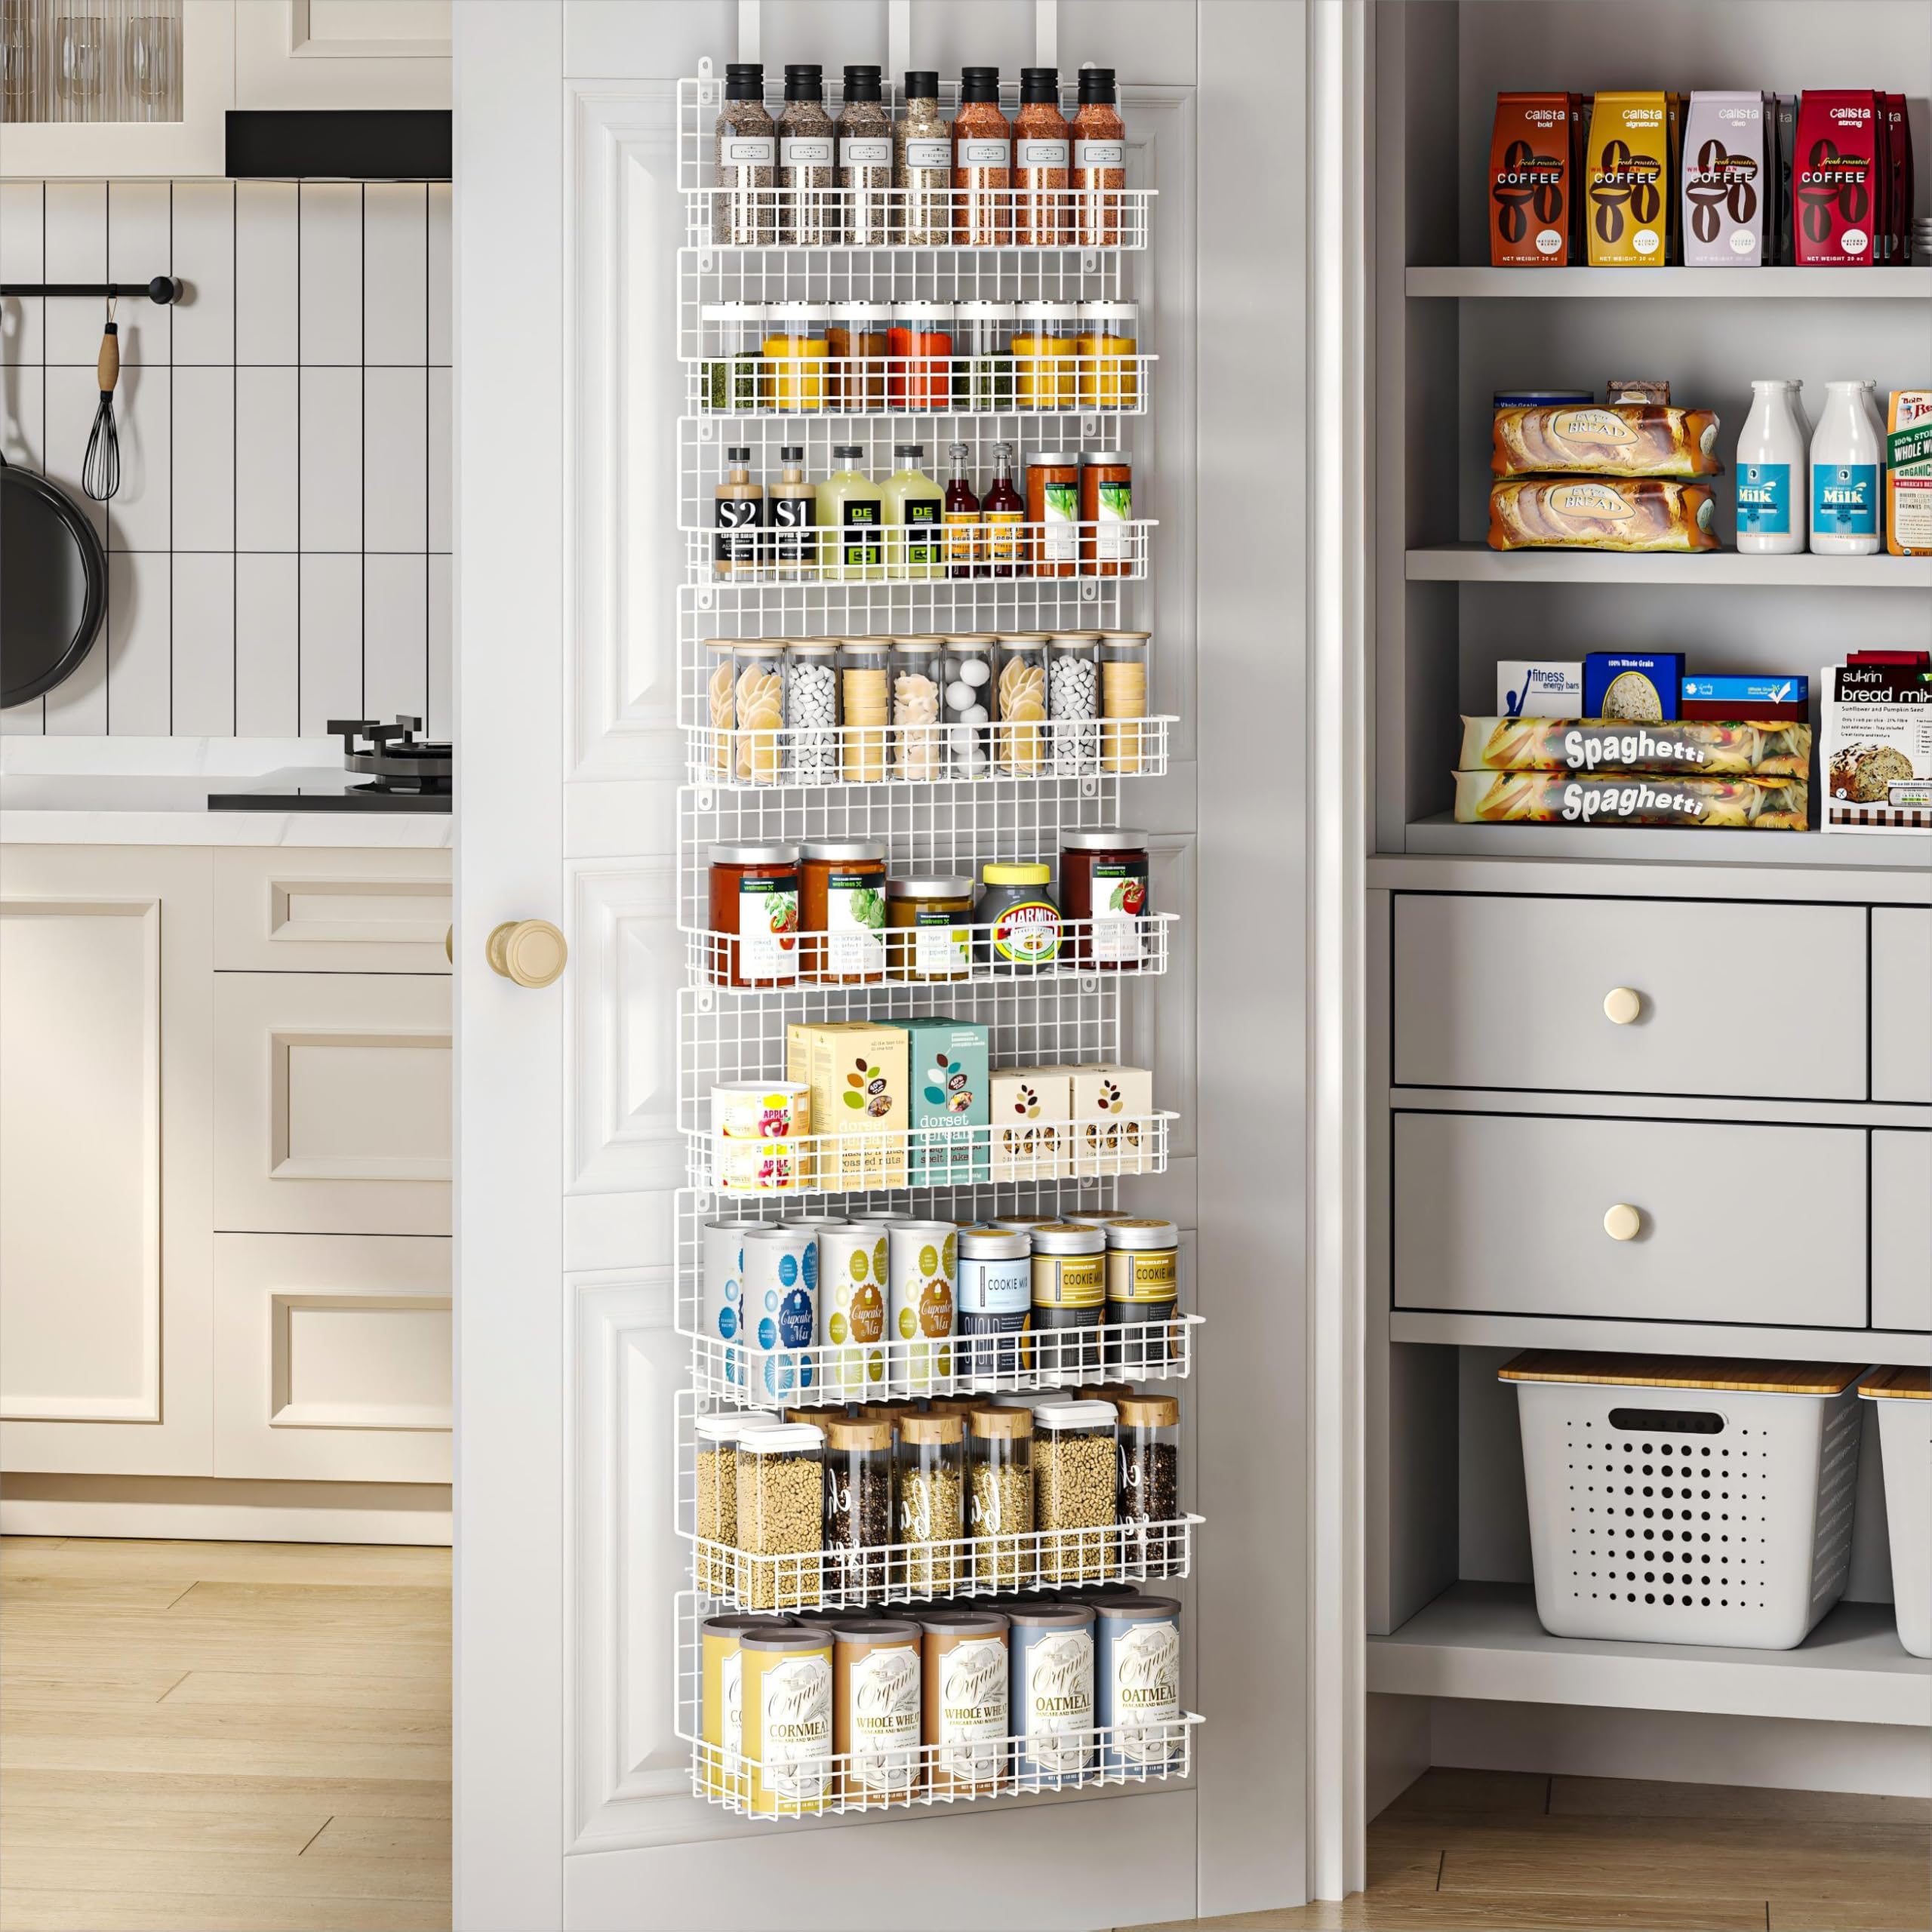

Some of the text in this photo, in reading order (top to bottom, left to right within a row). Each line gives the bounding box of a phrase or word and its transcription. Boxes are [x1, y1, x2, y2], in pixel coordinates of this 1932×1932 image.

[1838, 119, 1863, 128] strong
[1513, 158, 1565, 168] fresh roasted
[1610, 158, 1634, 168] fresh
[1817, 157, 1871, 167] fresh roasted
[1497, 173, 1560, 184] COFFEE
[1594, 173, 1657, 184] COFFEE
[1690, 172, 1753, 183] COFFEE
[1801, 172, 1865, 183] COFFEE
[1569, 422, 1627, 438] BREAD
[1894, 436, 1912, 447] 100%
[1894, 441, 1922, 462] WHOLE
[1739, 488, 1773, 503] Milk
[1823, 489, 1863, 503] Milk
[913, 507, 933, 517] DE
[1565, 497, 1624, 513] BREAD
[719, 500, 756, 528] S2
[775, 500, 807, 528] S1
[852, 508, 872, 518] DE
[1532, 669, 1564, 682] fitness
[1842, 669, 1883, 683] sukrin
[1543, 681, 1580, 691] energy bars
[1841, 685, 1893, 702] bread
[1564, 729, 1705, 770] Spaghetti
[1561, 782, 1703, 823] Spaghetti
[763, 1109, 788, 1118] APPLE
[920, 1113, 969, 1128] dorset
[1063, 1273, 1093, 1285] COOKIE
[1137, 1268, 1165, 1280] COOKIE
[988, 1278, 1017, 1291] COOKIE
[851, 1304, 883, 1323] Cupcake
[921, 1300, 952, 1318] Cupcake
[780, 1309, 811, 1328] Cupcake
[931, 1315, 949, 1331] Mix
[790, 1326, 809, 1341] Mix
[860, 1321, 879, 1337] Mix
[1118, 1638, 1175, 1685] Organic
[1032, 1645, 1089, 1696] Organic
[857, 1662, 916, 1713] Organic
[945, 1654, 1003, 1706] Organic
[768, 1670, 826, 1719] Organic
[1121, 1684, 1177, 1703] OATMEAL
[1035, 1693, 1091, 1711] OATMEAL
[945, 1708, 982, 1720] WHOLE
[770, 1721, 829, 1738] CORNMEAL
[857, 1717, 894, 1728] WHOLE
